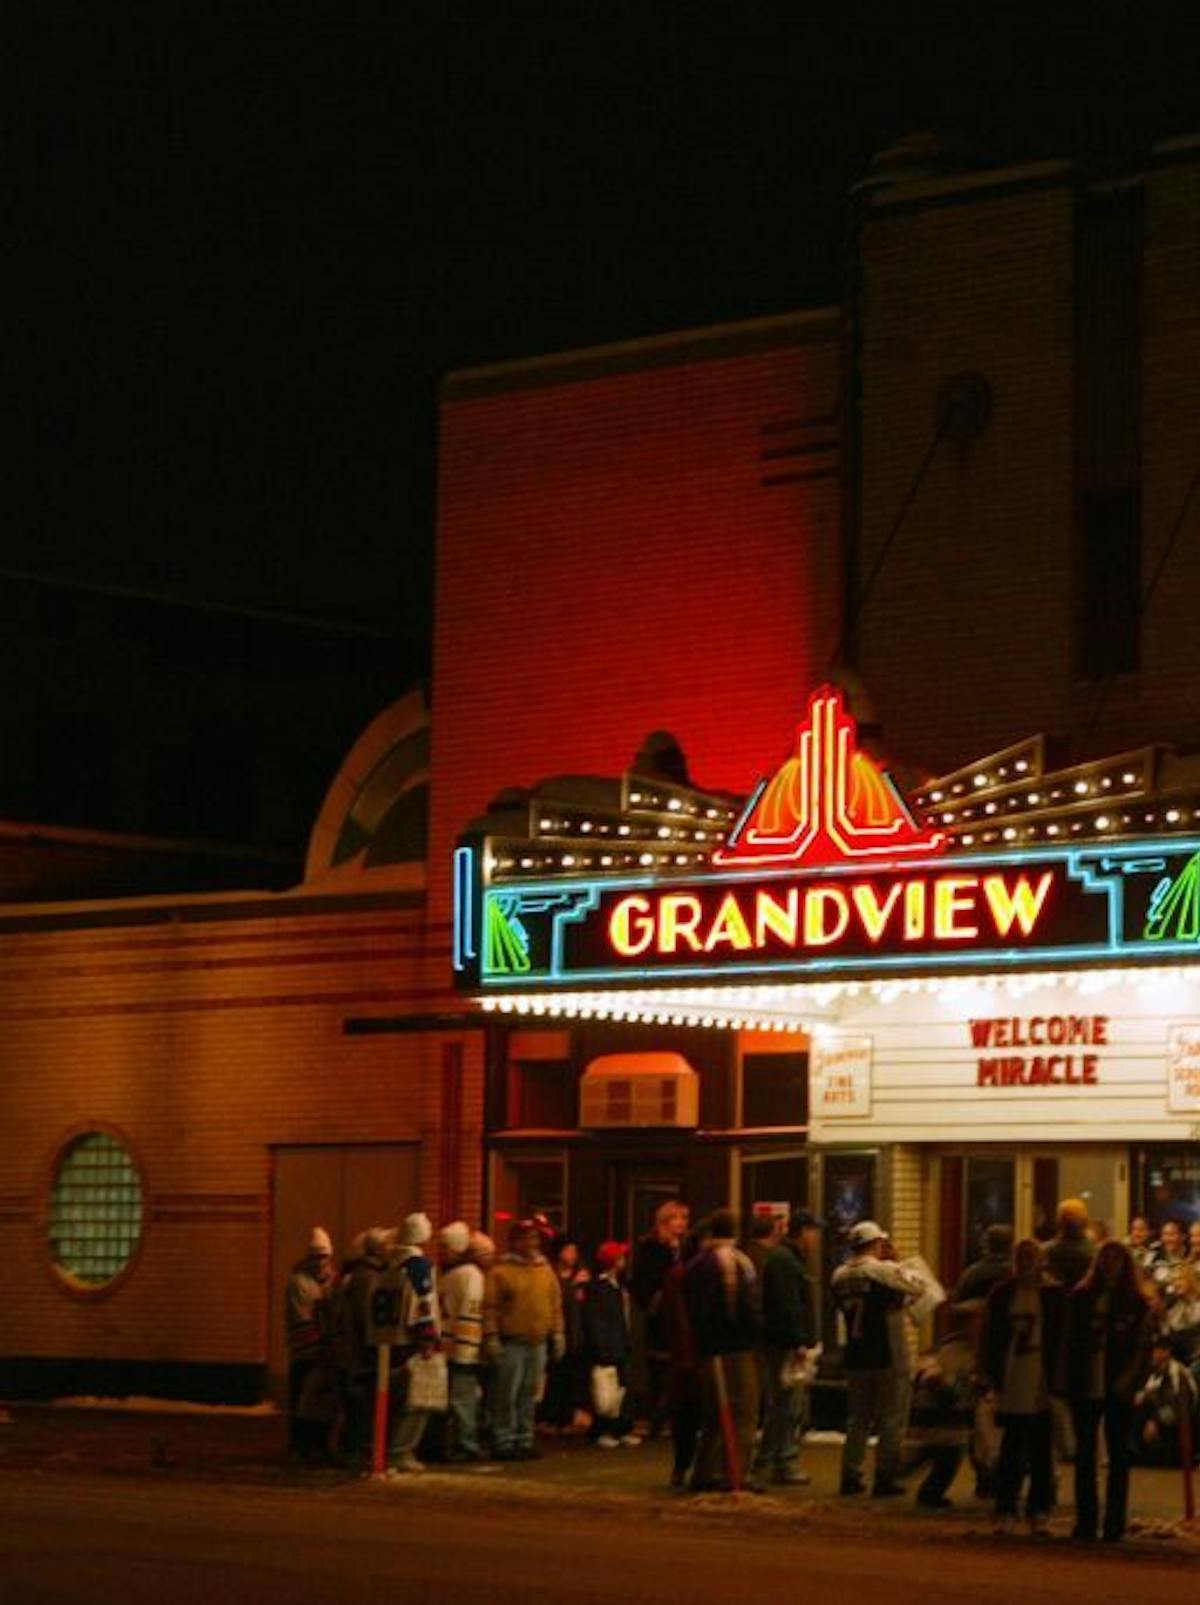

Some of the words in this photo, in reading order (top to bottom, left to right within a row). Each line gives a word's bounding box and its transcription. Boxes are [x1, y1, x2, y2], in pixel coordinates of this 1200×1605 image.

[609, 872, 1053, 957] GRANDVIEW
[969, 1016, 1108, 1048] WELCOME
[977, 1055, 1098, 1087] MIRACLE
